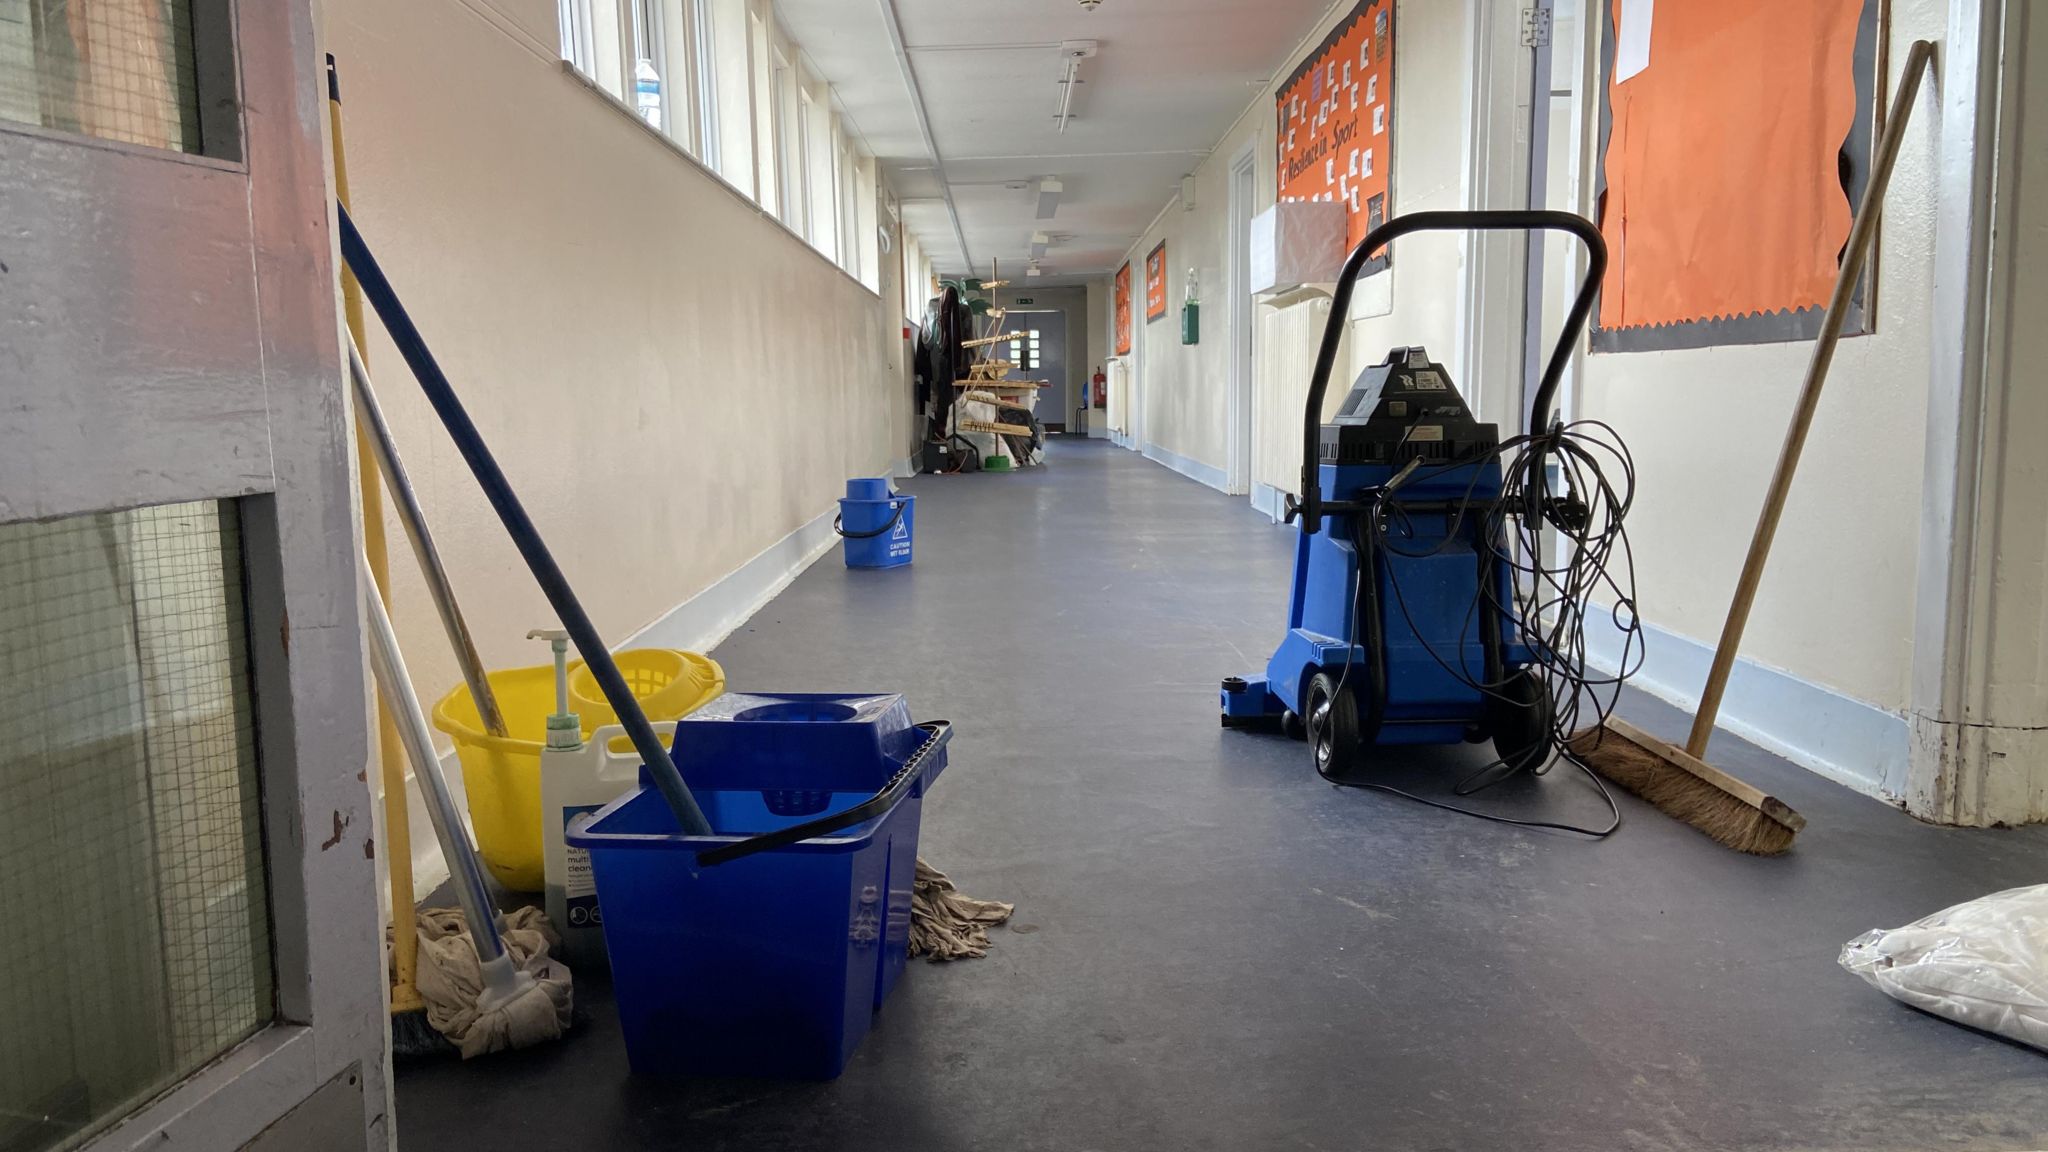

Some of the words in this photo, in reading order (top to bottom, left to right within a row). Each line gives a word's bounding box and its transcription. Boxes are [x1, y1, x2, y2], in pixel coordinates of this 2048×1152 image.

[1289, 143, 1318, 183] Resilience
[1319, 131, 1327, 157] in
[1331, 113, 1358, 160] Sport
[890, 541, 910, 550] CAUTION
[890, 550, 898, 558] WET
[898, 548, 910, 556] FLOOR
[568, 865, 592, 873] clean
